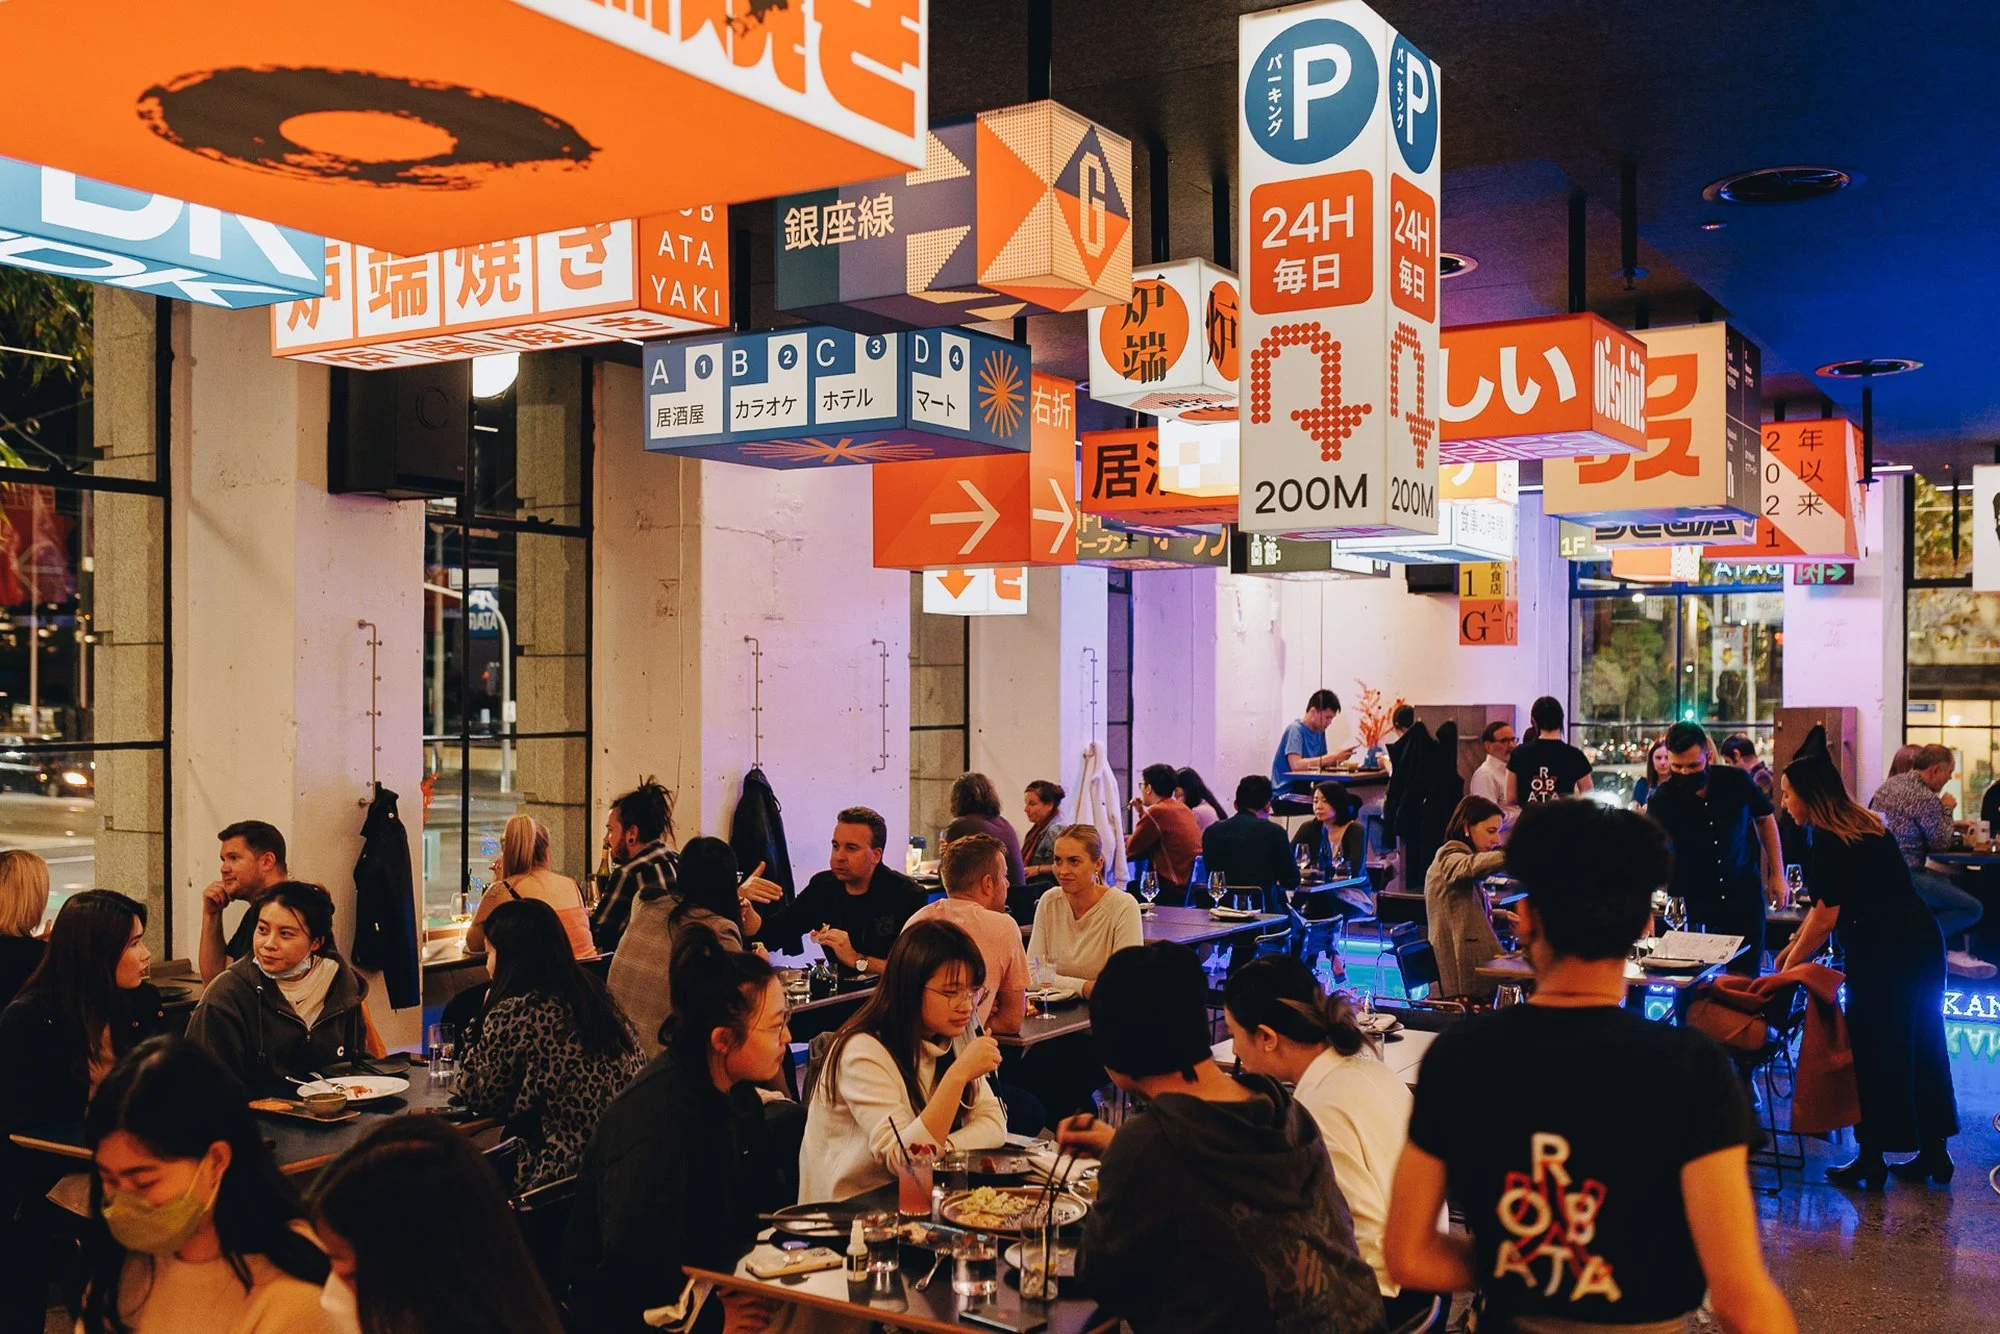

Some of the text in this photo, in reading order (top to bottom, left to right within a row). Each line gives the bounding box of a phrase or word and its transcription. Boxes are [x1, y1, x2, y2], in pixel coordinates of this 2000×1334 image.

[1267, 53, 1283, 137] パーキング
[1294, 43, 1352, 141] P
[1396, 48, 1404, 129] パーキング
[1407, 52, 1429, 145] P
[784, 192, 895, 252] 銀座線
[1262, 195, 1354, 249] 24H
[1394, 200, 1430, 258] 24H
[658, 229, 714, 271] ATA
[1272, 253, 1340, 294] 毎日
[1398, 256, 1425, 303] 毎日
[651, 273, 720, 317] YAKI
[731, 349, 749, 377] B
[816, 338, 835, 367] C
[914, 336, 929, 363] D
[650, 359, 669, 386] A
[1439, 345, 1577, 423] しい
[656, 404, 704, 428] 居酒屋
[735, 394, 798, 420] カラオケ
[823, 388, 874, 412] ホテル
[916, 388, 957, 417] マート
[1032, 385, 1072, 430] 右折
[1255, 473, 1368, 514] 200M
[1765, 430, 1781, 549] 2021
[1798, 428, 1824, 517] 年以来
[1391, 476, 1434, 518] 200M
[1560, 536, 1586, 555] 1F
[1463, 569, 1477, 597] 1
[1462, 610, 1489, 642] G
[1531, 779, 1555, 791] OB
[1540, 766, 1549, 779] R
[1531, 1132, 1573, 1188] R
[1499, 1188, 1596, 1246] OB
[1493, 1239, 1622, 1302] ATA
